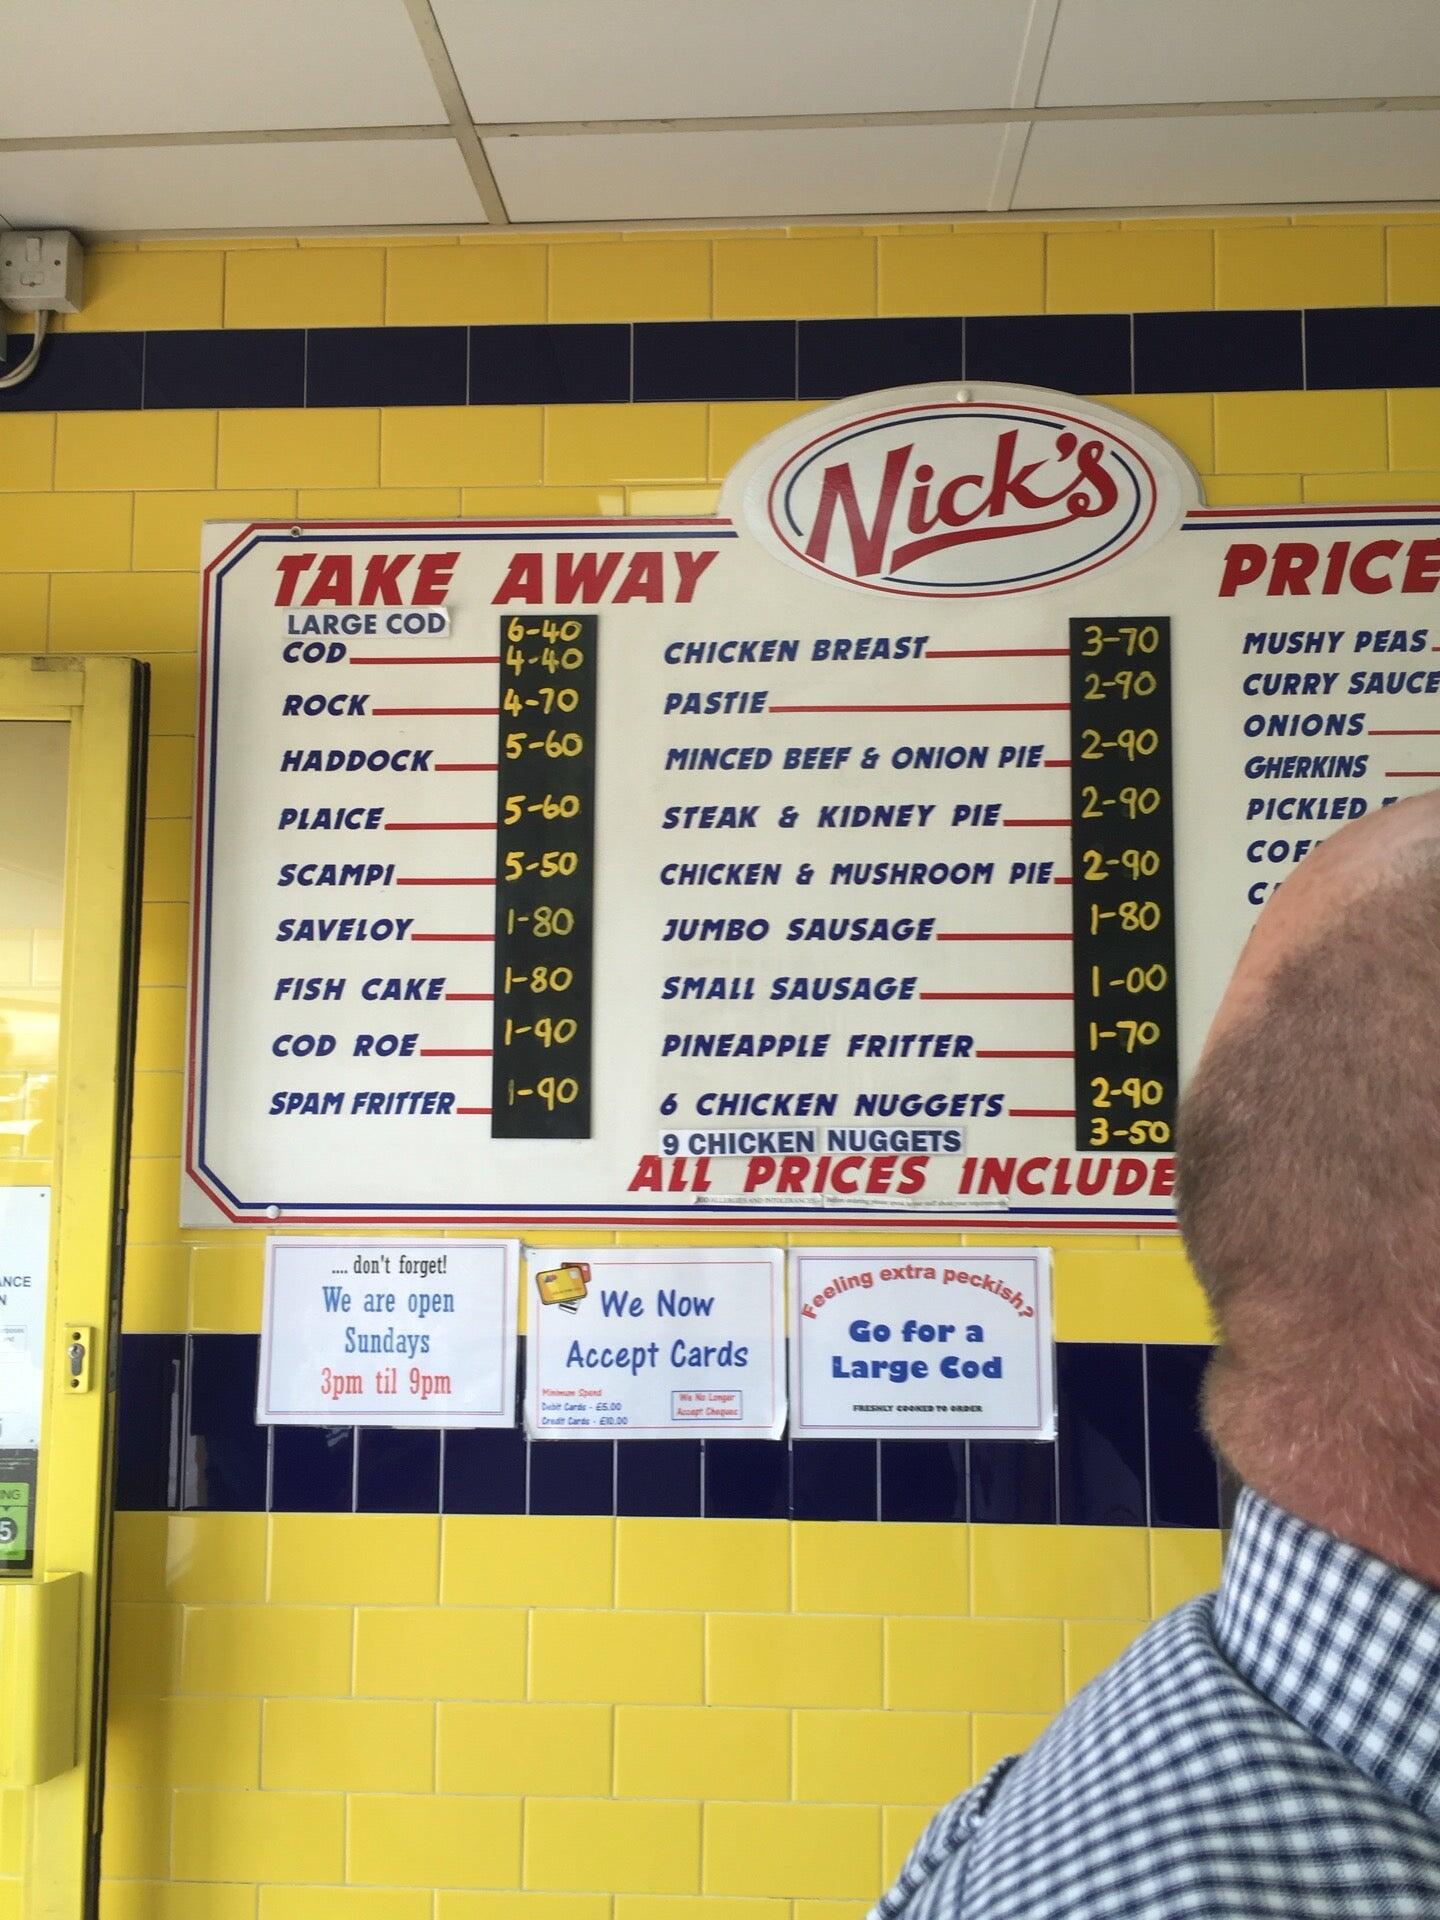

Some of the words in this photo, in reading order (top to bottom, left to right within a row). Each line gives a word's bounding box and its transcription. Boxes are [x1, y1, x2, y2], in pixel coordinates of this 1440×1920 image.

[804, 428, 1119, 578] Nick's
[275, 551, 459, 607] TAKE
[492, 551, 716, 605] AWAY
[1220, 539, 1440, 596] PRICE
[288, 614, 376, 635] LARGE
[386, 612, 446, 633] COD
[507, 616, 581, 644] 6-40
[664, 640, 799, 664] CHICKEN
[812, 636, 929, 661] BREAST
[1084, 625, 1158, 657] 3-70
[1244, 631, 1341, 653] MUSHY
[1355, 631, 1426, 652] PEAS
[283, 642, 345, 661] COD
[505, 645, 583, 674] 4-40
[664, 691, 767, 714] PASTIE
[1085, 671, 1156, 700] 2-90
[1243, 672, 1336, 695] CURRY
[1348, 671, 1440, 694] SAUCE
[282, 694, 370, 717] ROCK
[503, 687, 579, 717] 4-70
[1244, 714, 1364, 737] ONIONS
[281, 749, 433, 772] HADDOCK
[505, 729, 583, 760] 5-60
[667, 747, 774, 769] MINCED
[784, 747, 851, 769] BEEF
[862, 748, 879, 769] &
[891, 746, 989, 769] ONION
[999, 745, 1044, 768] PIE
[1082, 728, 1158, 760] 2-90
[1245, 754, 1367, 779] GHERKINS
[279, 807, 382, 829] PLAICE
[503, 794, 580, 826] 5-60
[664, 806, 756, 828] STEAK
[779, 807, 798, 827] &
[819, 804, 934, 827] KIDNEY
[953, 803, 1000, 826] PIE
[1082, 785, 1160, 818] 2-90
[1248, 797, 1368, 820] PICKLED
[278, 863, 394, 886] SCAMPI
[505, 851, 578, 881] 5-50
[660, 863, 781, 885] CHICKEN
[796, 866, 813, 885] &
[831, 863, 995, 885] MUSHROOM
[1011, 862, 1052, 884] PIE
[1083, 849, 1160, 881] 2-90
[276, 918, 411, 942] SAVELOY
[507, 905, 574, 936] 1-80
[664, 918, 770, 941] JUMBO
[788, 917, 934, 942] SAUSAGE
[1090, 901, 1161, 935] 1-80
[275, 977, 346, 1001] FISH
[361, 977, 445, 1001] CAKE
[504, 966, 573, 993] 1-80
[661, 976, 754, 1000] SMALL
[771, 976, 917, 1001] SAUSAGE
[272, 1034, 337, 1057] COD
[353, 1033, 418, 1057] ROE
[504, 1017, 577, 1048] 1-90
[661, 1034, 830, 1058] PINEAPPLE
[848, 1034, 975, 1058] FRITTER
[1089, 1020, 1160, 1054] 1-70
[268, 1091, 346, 1116] SPAM
[351, 1091, 457, 1115] FRITTER
[509, 1076, 578, 1111] 1-90
[659, 1094, 679, 1116] 6
[696, 1092, 839, 1117] CHICKEN
[854, 1093, 1005, 1118] NUGGETS
[1090, 1076, 1163, 1109] 2-90
[663, 1134, 680, 1156] 9
[688, 1130, 816, 1155] CHICKEN
[828, 1129, 962, 1153] NUGGETS
[1089, 1117, 1170, 1146] 3-50
[628, 1154, 710, 1193] ALL
[743, 1155, 928, 1195] PRICES
[959, 1156, 1176, 1196] INCLUDE
[353, 1255, 391, 1274] don't
[399, 1255, 447, 1279] forget!
[322, 1286, 353, 1313] We
[364, 1289, 396, 1313] are
[407, 1288, 456, 1317] open
[601, 1290, 645, 1318] We
[657, 1289, 716, 1317] Now
[801, 1270, 873, 1319] Feeling
[879, 1264, 936, 1282] extra
[943, 1268, 1034, 1318] peckish?
[344, 1327, 432, 1359] Sundays
[849, 1319, 892, 1343] Go
[901, 1319, 957, 1343] for
[966, 1324, 985, 1343] a
[566, 1340, 661, 1377] Accept
[670, 1338, 749, 1368] Cards
[832, 1355, 930, 1384] Large
[939, 1355, 1004, 1379] Cod
[320, 1368, 363, 1400] 3pm
[375, 1368, 398, 1395] til
[408, 1368, 453, 1400] 9pm
[852, 1405, 893, 1413] FRESHLY
[896, 1405, 934, 1413] COOKED
[936, 1405, 948, 1413] TO
[950, 1405, 983, 1413] ORDER
